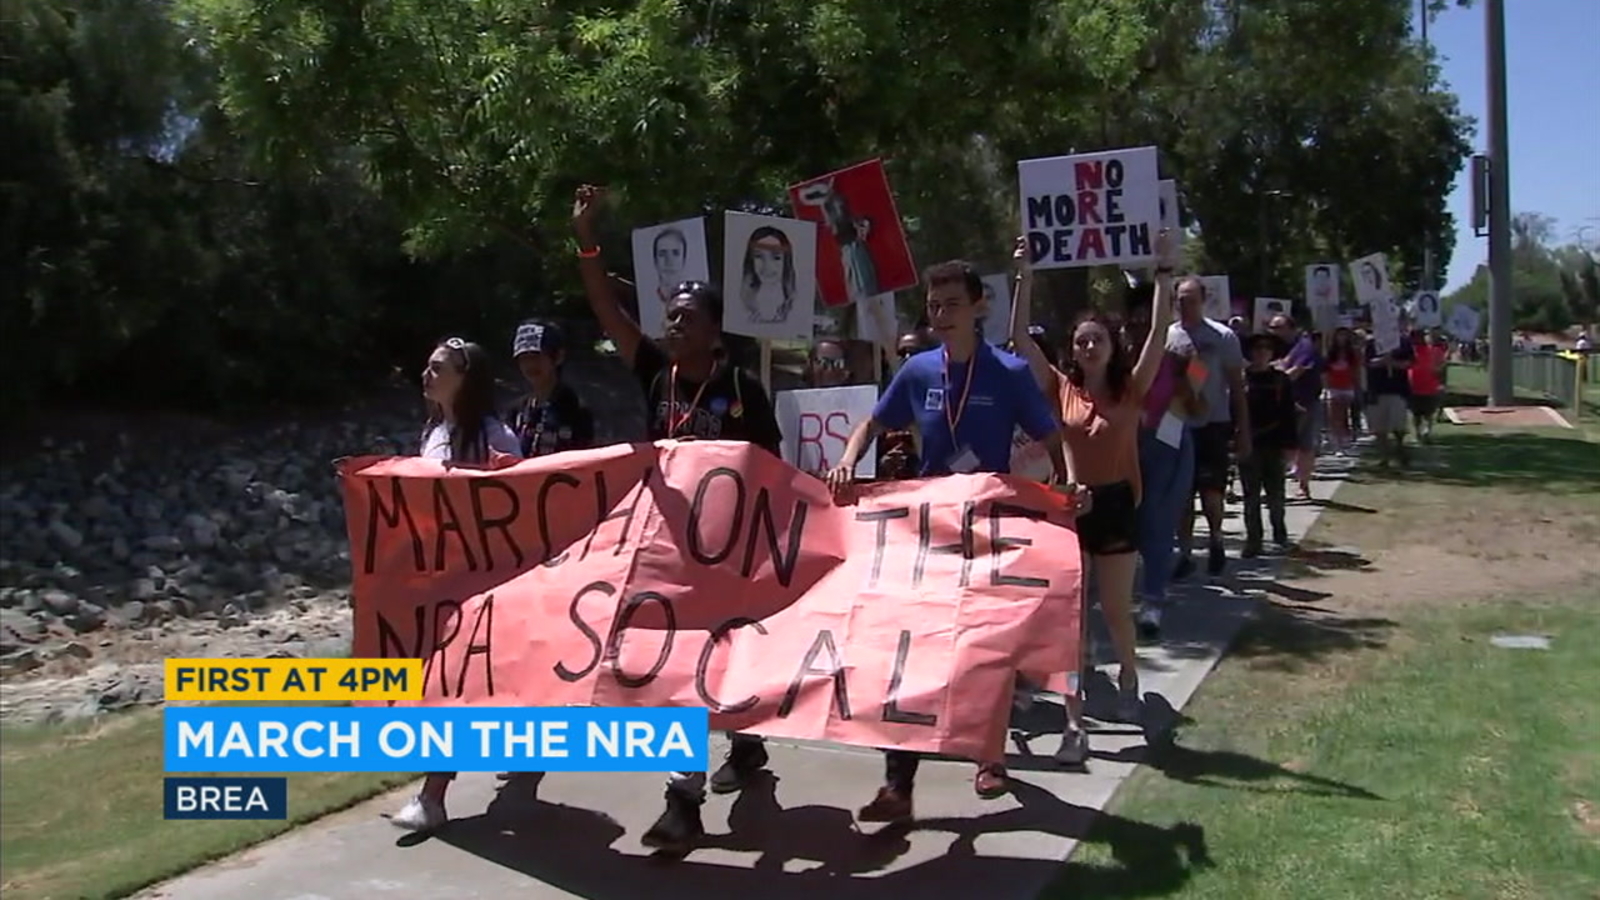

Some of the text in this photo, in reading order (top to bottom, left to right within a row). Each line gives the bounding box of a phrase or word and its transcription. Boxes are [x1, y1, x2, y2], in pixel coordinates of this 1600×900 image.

[1074, 159, 1124, 190] NO
[1027, 190, 1124, 229] MORE
[1027, 222, 1151, 263] DEATH
[364, 467, 1050, 588] MARCH ON THE
